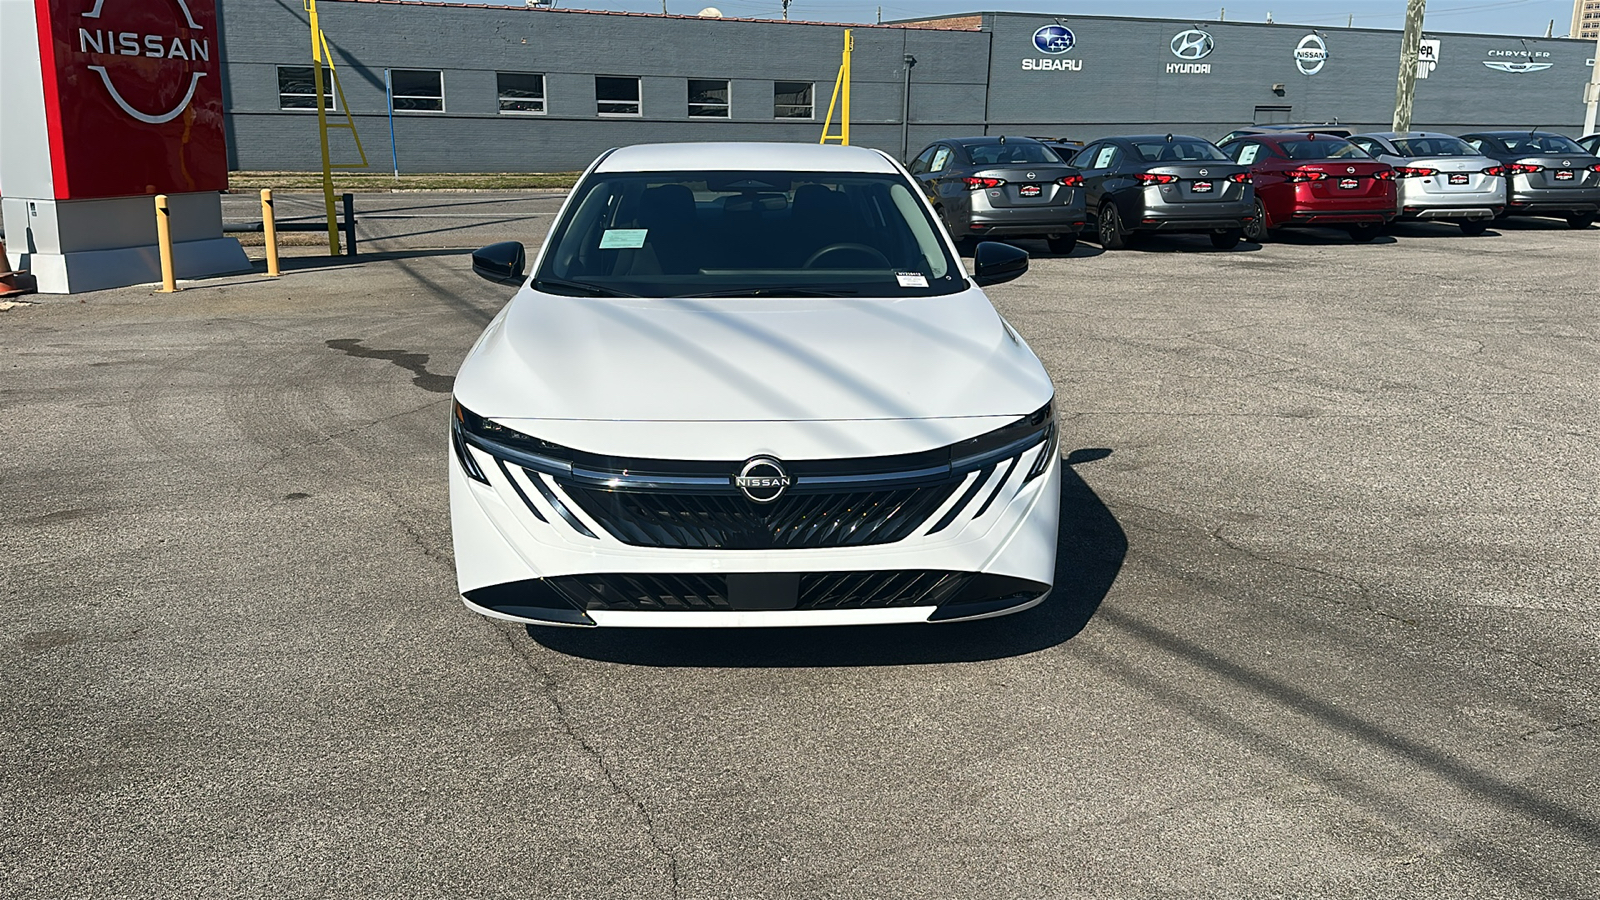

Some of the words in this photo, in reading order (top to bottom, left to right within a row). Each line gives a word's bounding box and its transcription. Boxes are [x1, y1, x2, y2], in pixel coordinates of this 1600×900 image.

[79, 27, 209, 62] NISSAN
[1296, 51, 1325, 59] NISSAN
[1487, 49, 1551, 58] CHRYSLER
[1021, 58, 1082, 71] SUBARU
[1166, 63, 1211, 74] HYUNDAI
[737, 478, 790, 487] NISSAN
